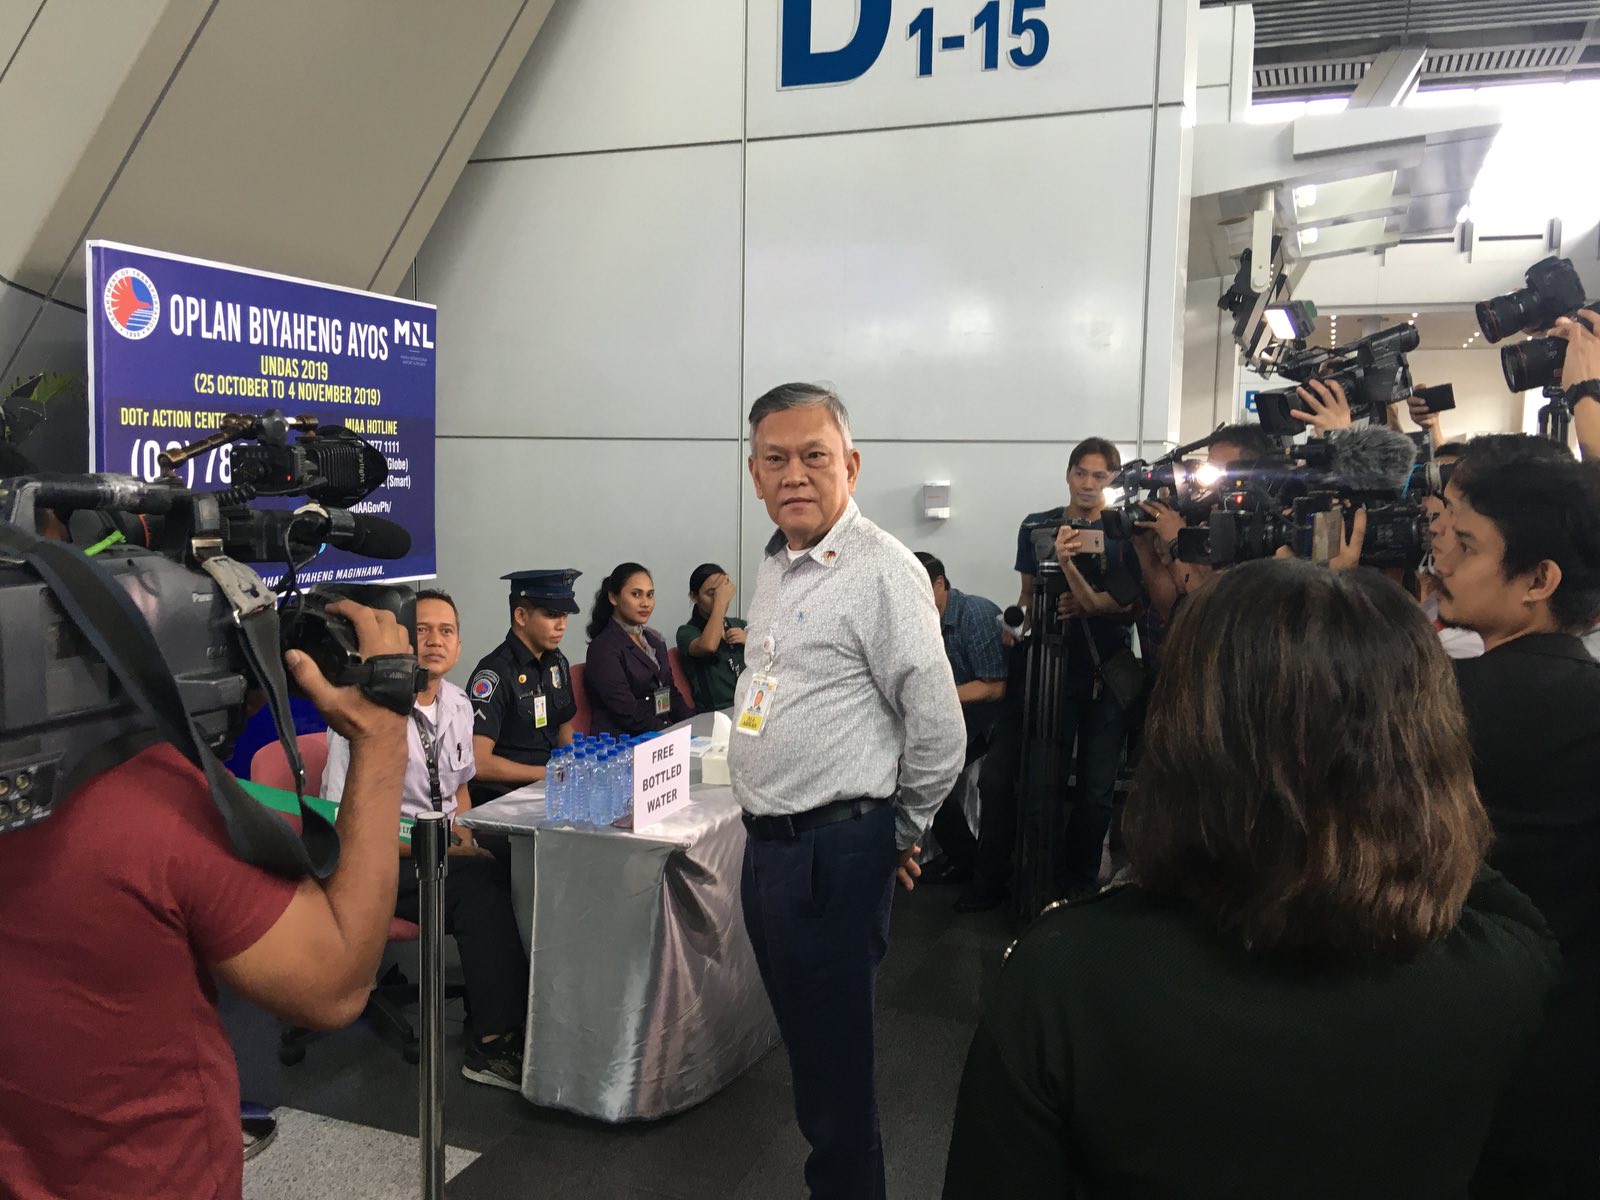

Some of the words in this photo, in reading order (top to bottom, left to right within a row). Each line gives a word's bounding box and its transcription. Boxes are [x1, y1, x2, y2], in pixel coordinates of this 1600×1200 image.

[777, 0, 892, 90] D
[906, 0, 1050, 78] 1-15
[170, 293, 241, 343] OPLAN
[249, 305, 343, 356] BIYAHENG
[347, 321, 389, 361] AYOS
[393, 318, 434, 349] MNL
[260, 354, 300, 379] UNDAS
[301, 359, 329, 381] 2019
[194, 372, 215, 394] (25
[217, 374, 269, 398] OCTOBER
[270, 379, 285, 399] TO
[288, 381, 296, 400] 4
[297, 382, 352, 404] NOVEMBER
[354, 387, 381, 406] 2019)
[120, 407, 149, 426] DOTr
[151, 409, 192, 428] ACTION
[344, 417, 365, 434] MIAA
[366, 419, 398, 435] HOTLINE
[384, 440, 400, 453] 1111
[131, 438, 195, 490] (0)
[386, 474, 411, 489] (Smart)
[262, 575, 284, 587] AHA
[335, 565, 385, 580] MAGINHAWA.
[651, 743, 675, 765] FREE
[642, 763, 682, 792] BOTTLED
[647, 788, 678, 814] WATER
